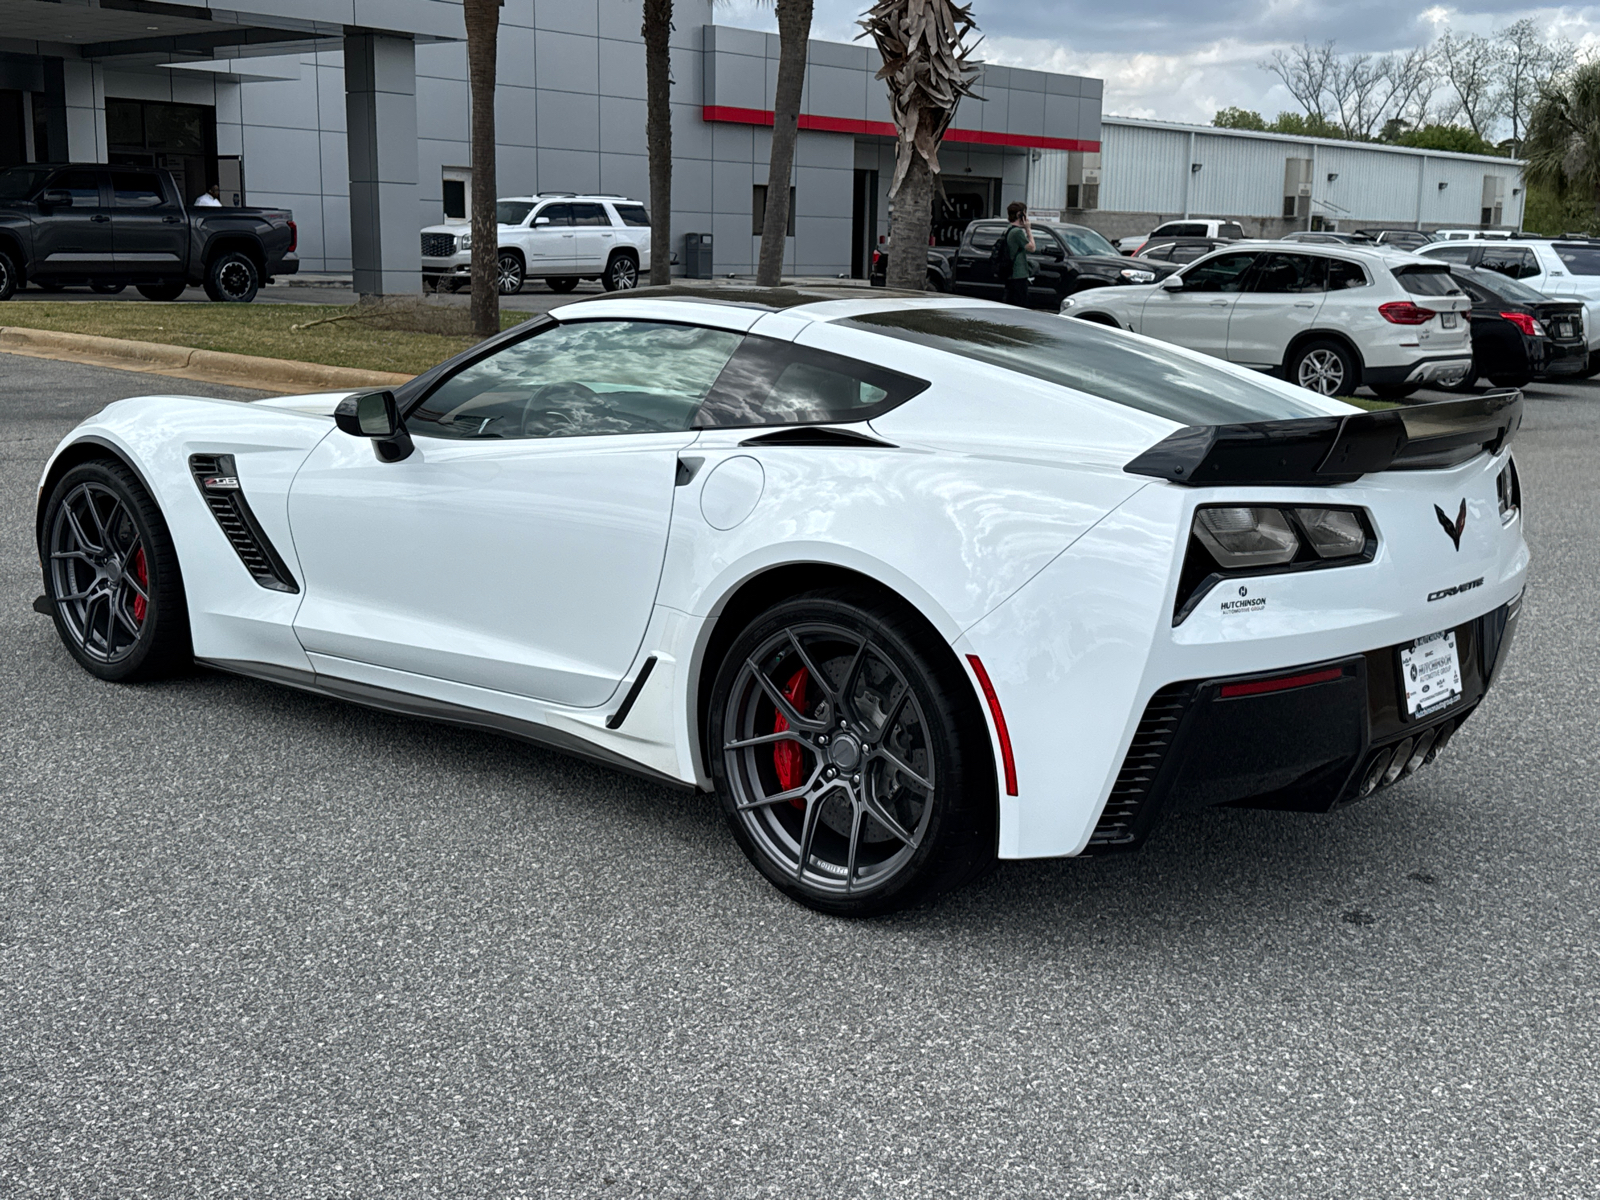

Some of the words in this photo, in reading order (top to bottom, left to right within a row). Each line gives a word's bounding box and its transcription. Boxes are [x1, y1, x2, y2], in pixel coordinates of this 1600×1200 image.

[1427, 576, 1485, 602] CORVETTE
[1221, 597, 1266, 610] HUTCHINSON
[1418, 654, 1452, 676] HUTCHINSON
